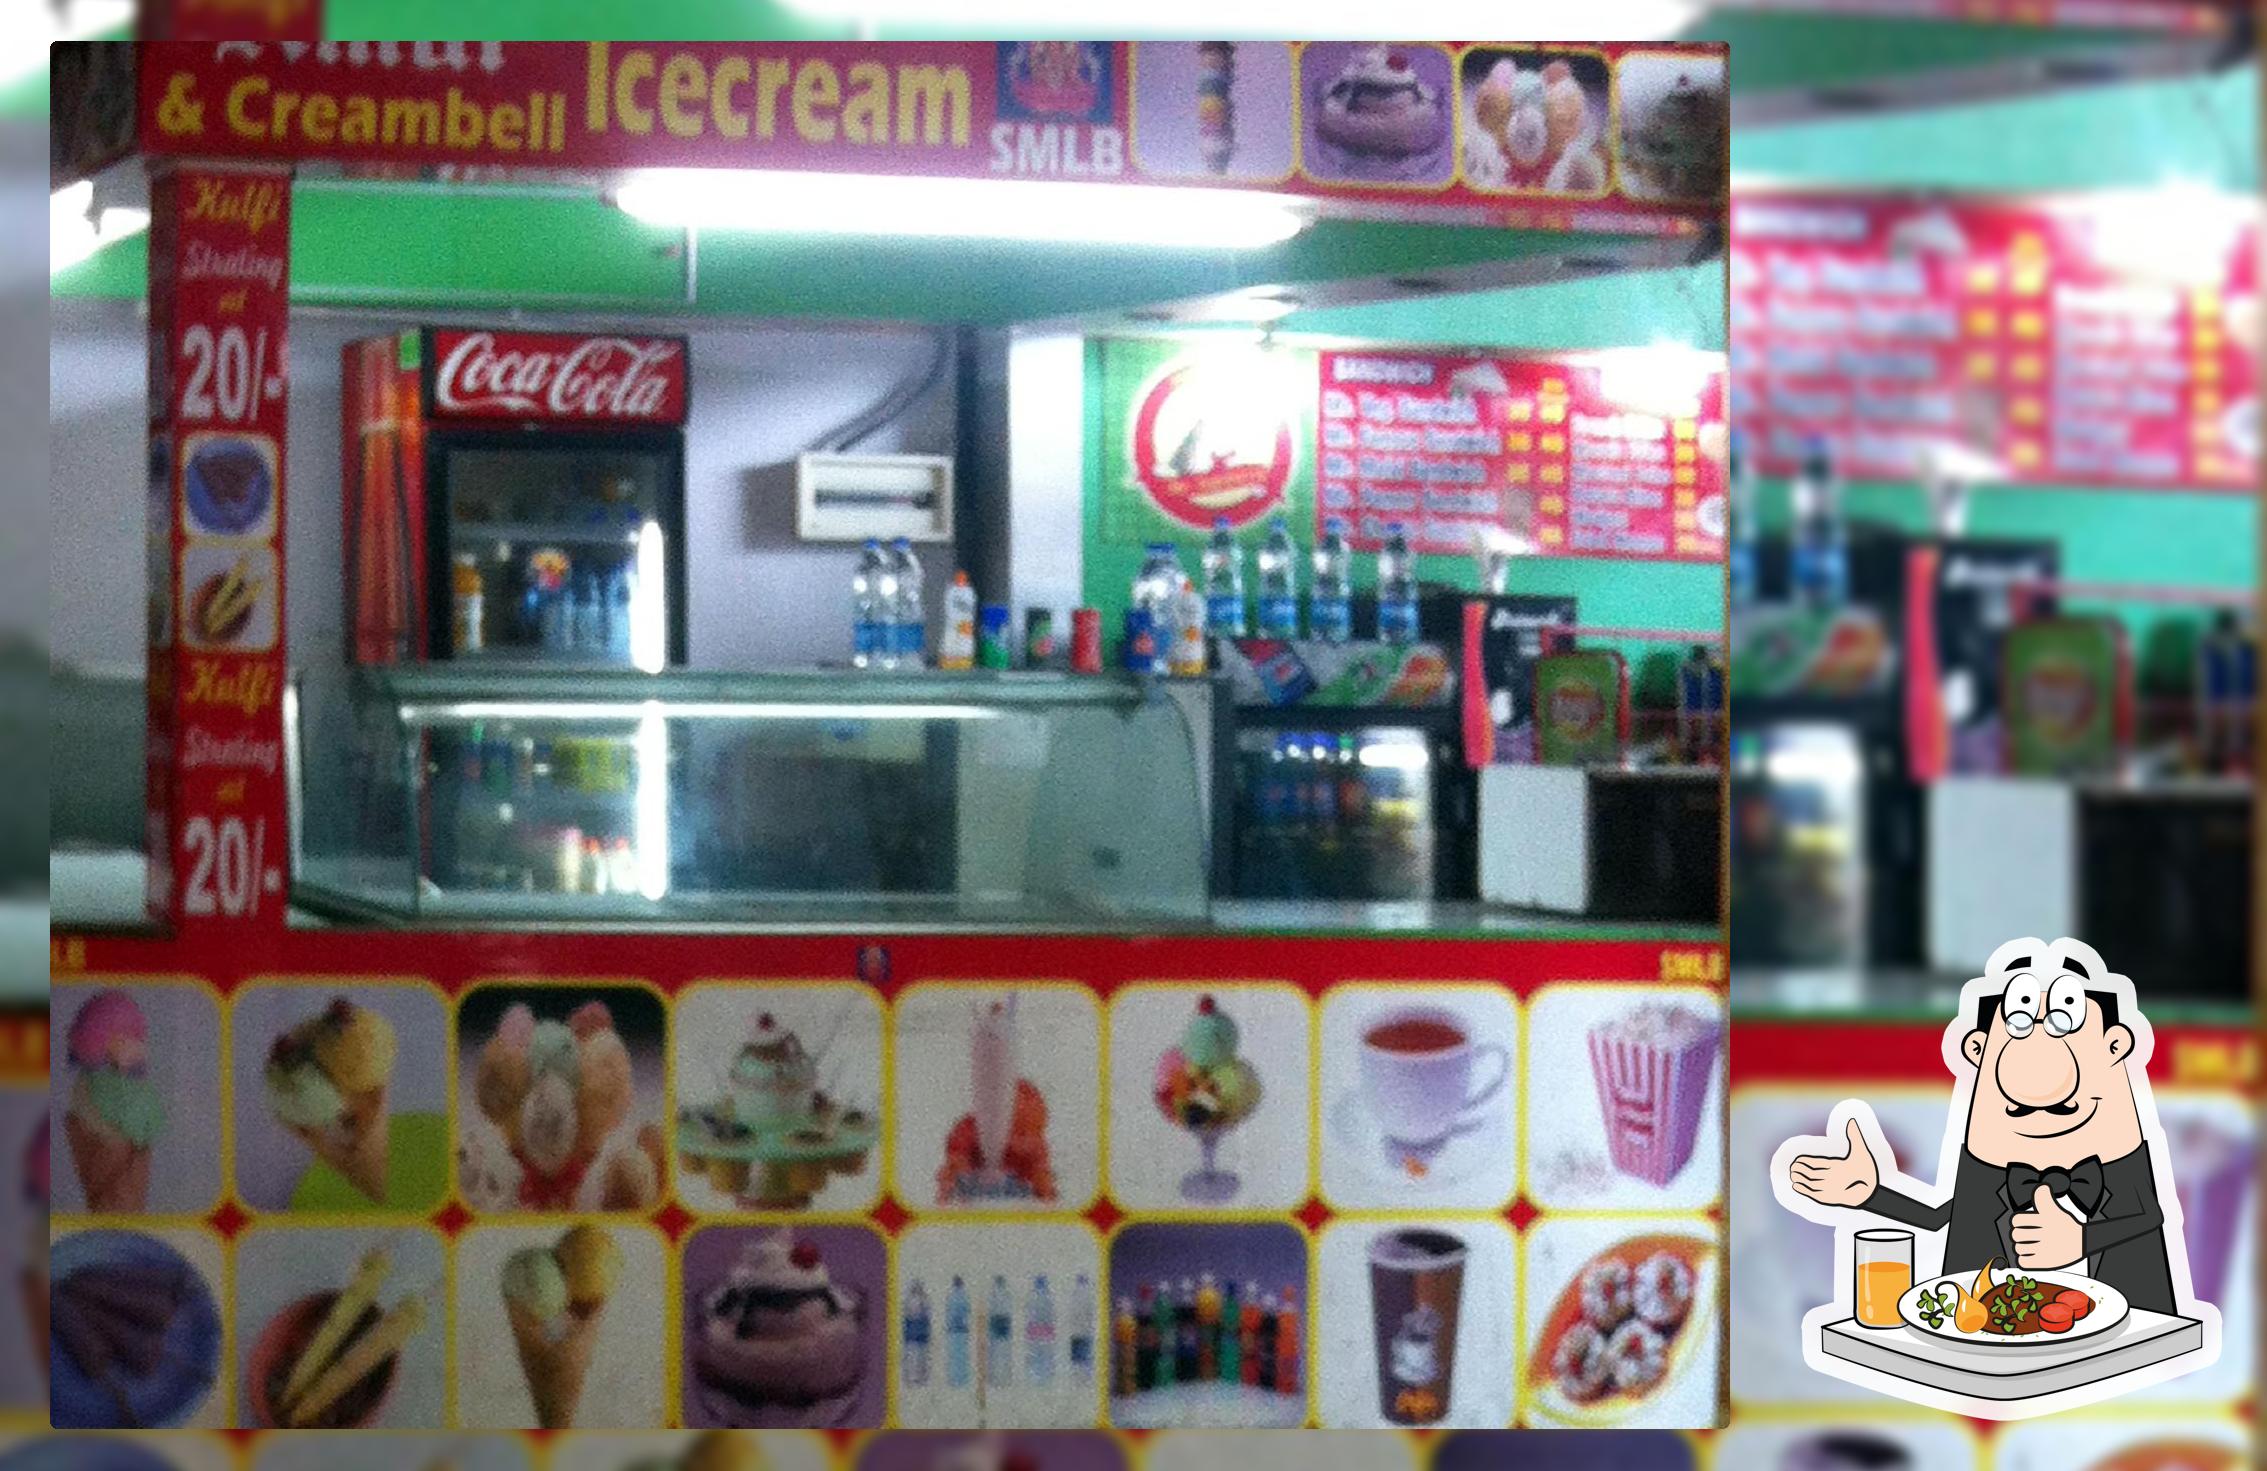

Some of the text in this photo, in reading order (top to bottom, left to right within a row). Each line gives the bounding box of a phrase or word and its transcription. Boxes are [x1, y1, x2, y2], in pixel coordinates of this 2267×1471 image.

[157, 73, 566, 152] & Creambell
[585, 41, 973, 148] Icecream
[990, 121, 1124, 177] SMLB
[184, 178, 282, 233] Kulfi
[436, 331, 683, 416] Coca-Cola
